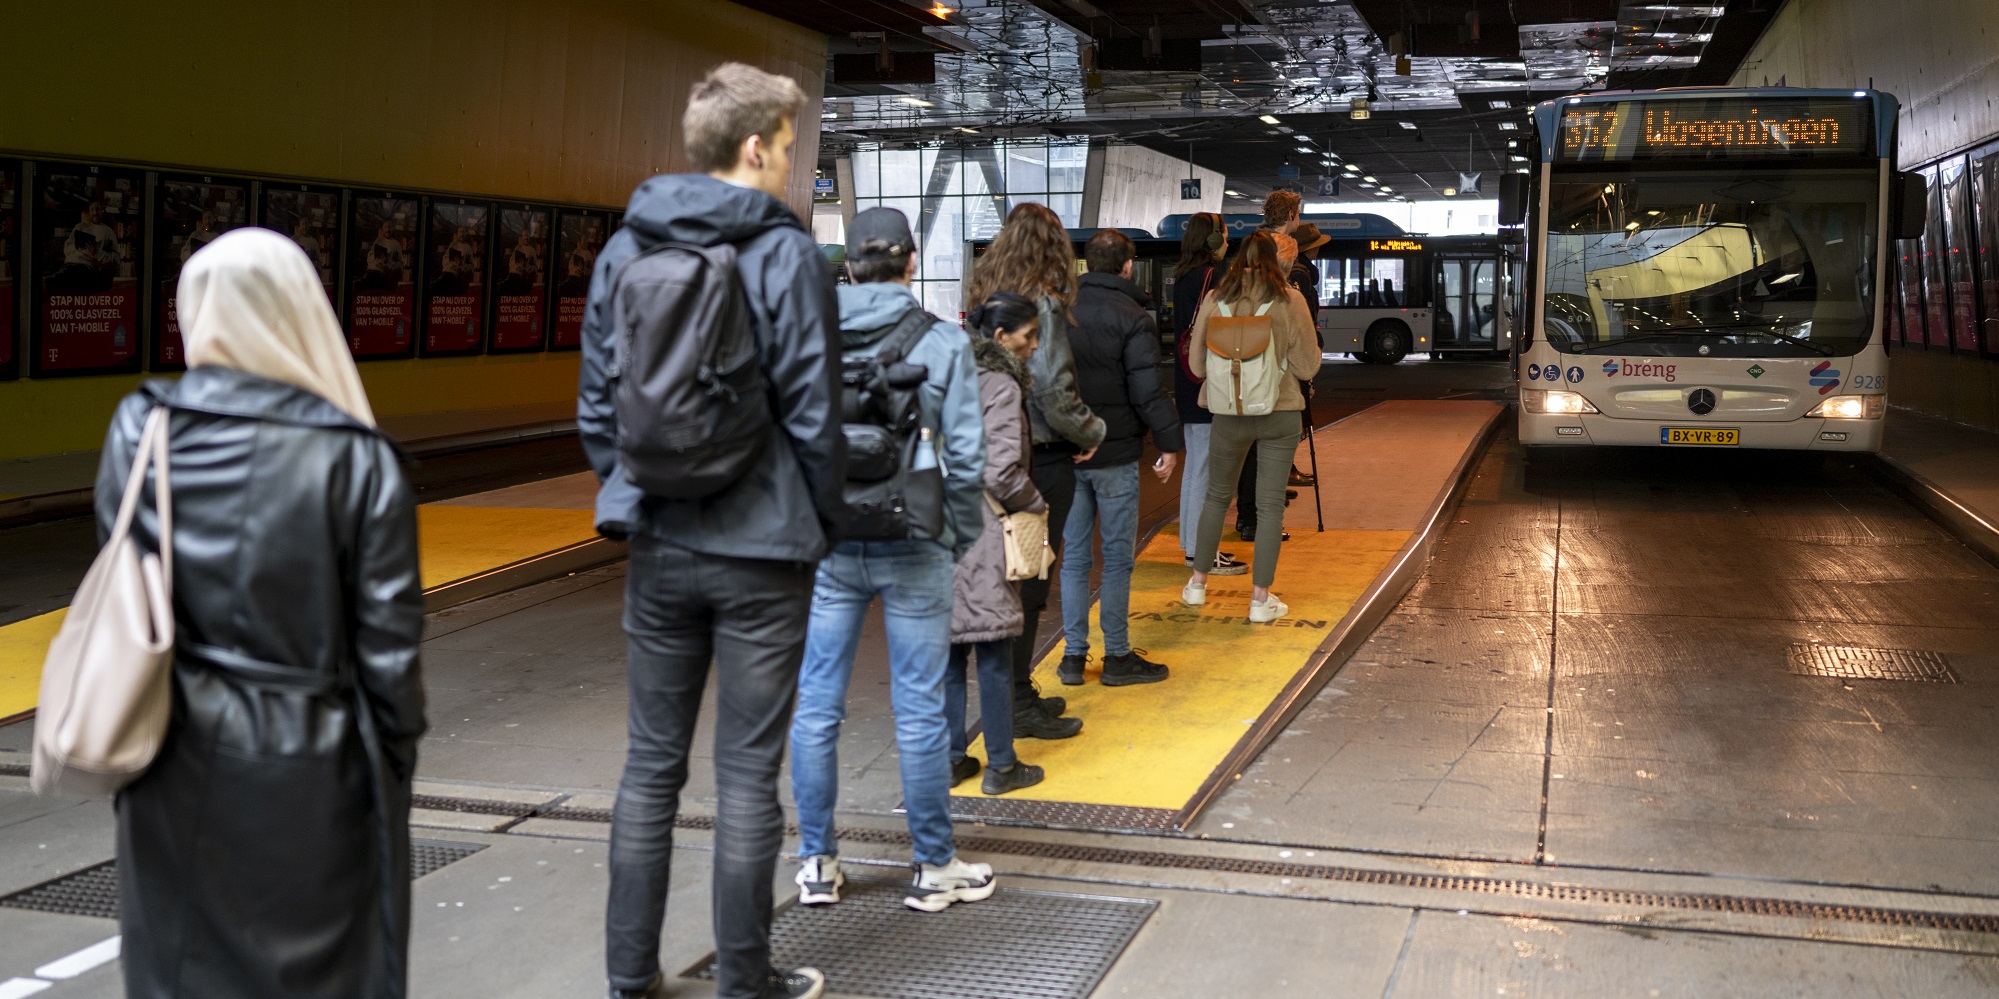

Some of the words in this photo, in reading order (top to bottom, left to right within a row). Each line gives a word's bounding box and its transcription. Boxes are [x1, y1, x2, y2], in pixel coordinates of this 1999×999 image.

[1565, 111, 1618, 147] 352
[1646, 108, 1838, 146] Wageningen
[1183, 186, 1199, 198] 10
[1325, 183, 1333, 195] 9
[50, 295, 72, 306] STAP
[74, 295, 87, 306] NU
[88, 295, 111, 306] OVER
[112, 295, 124, 306] OP
[356, 295, 371, 305] STAP
[372, 296, 380, 305] NU
[380, 296, 396, 305] OVER
[396, 296, 405, 305] OP
[50, 309, 74, 320] 100%
[75, 308, 122, 319] GLASVEZEL
[356, 306, 371, 316] 100%
[355, 317, 367, 326] VAN
[50, 322, 68, 334] VAN
[70, 322, 110, 333] T-MOBILE
[1622, 359, 1676, 382] breng
[1854, 375, 1886, 389] 9283
[1673, 431, 1734, 442] BX-VR-89
